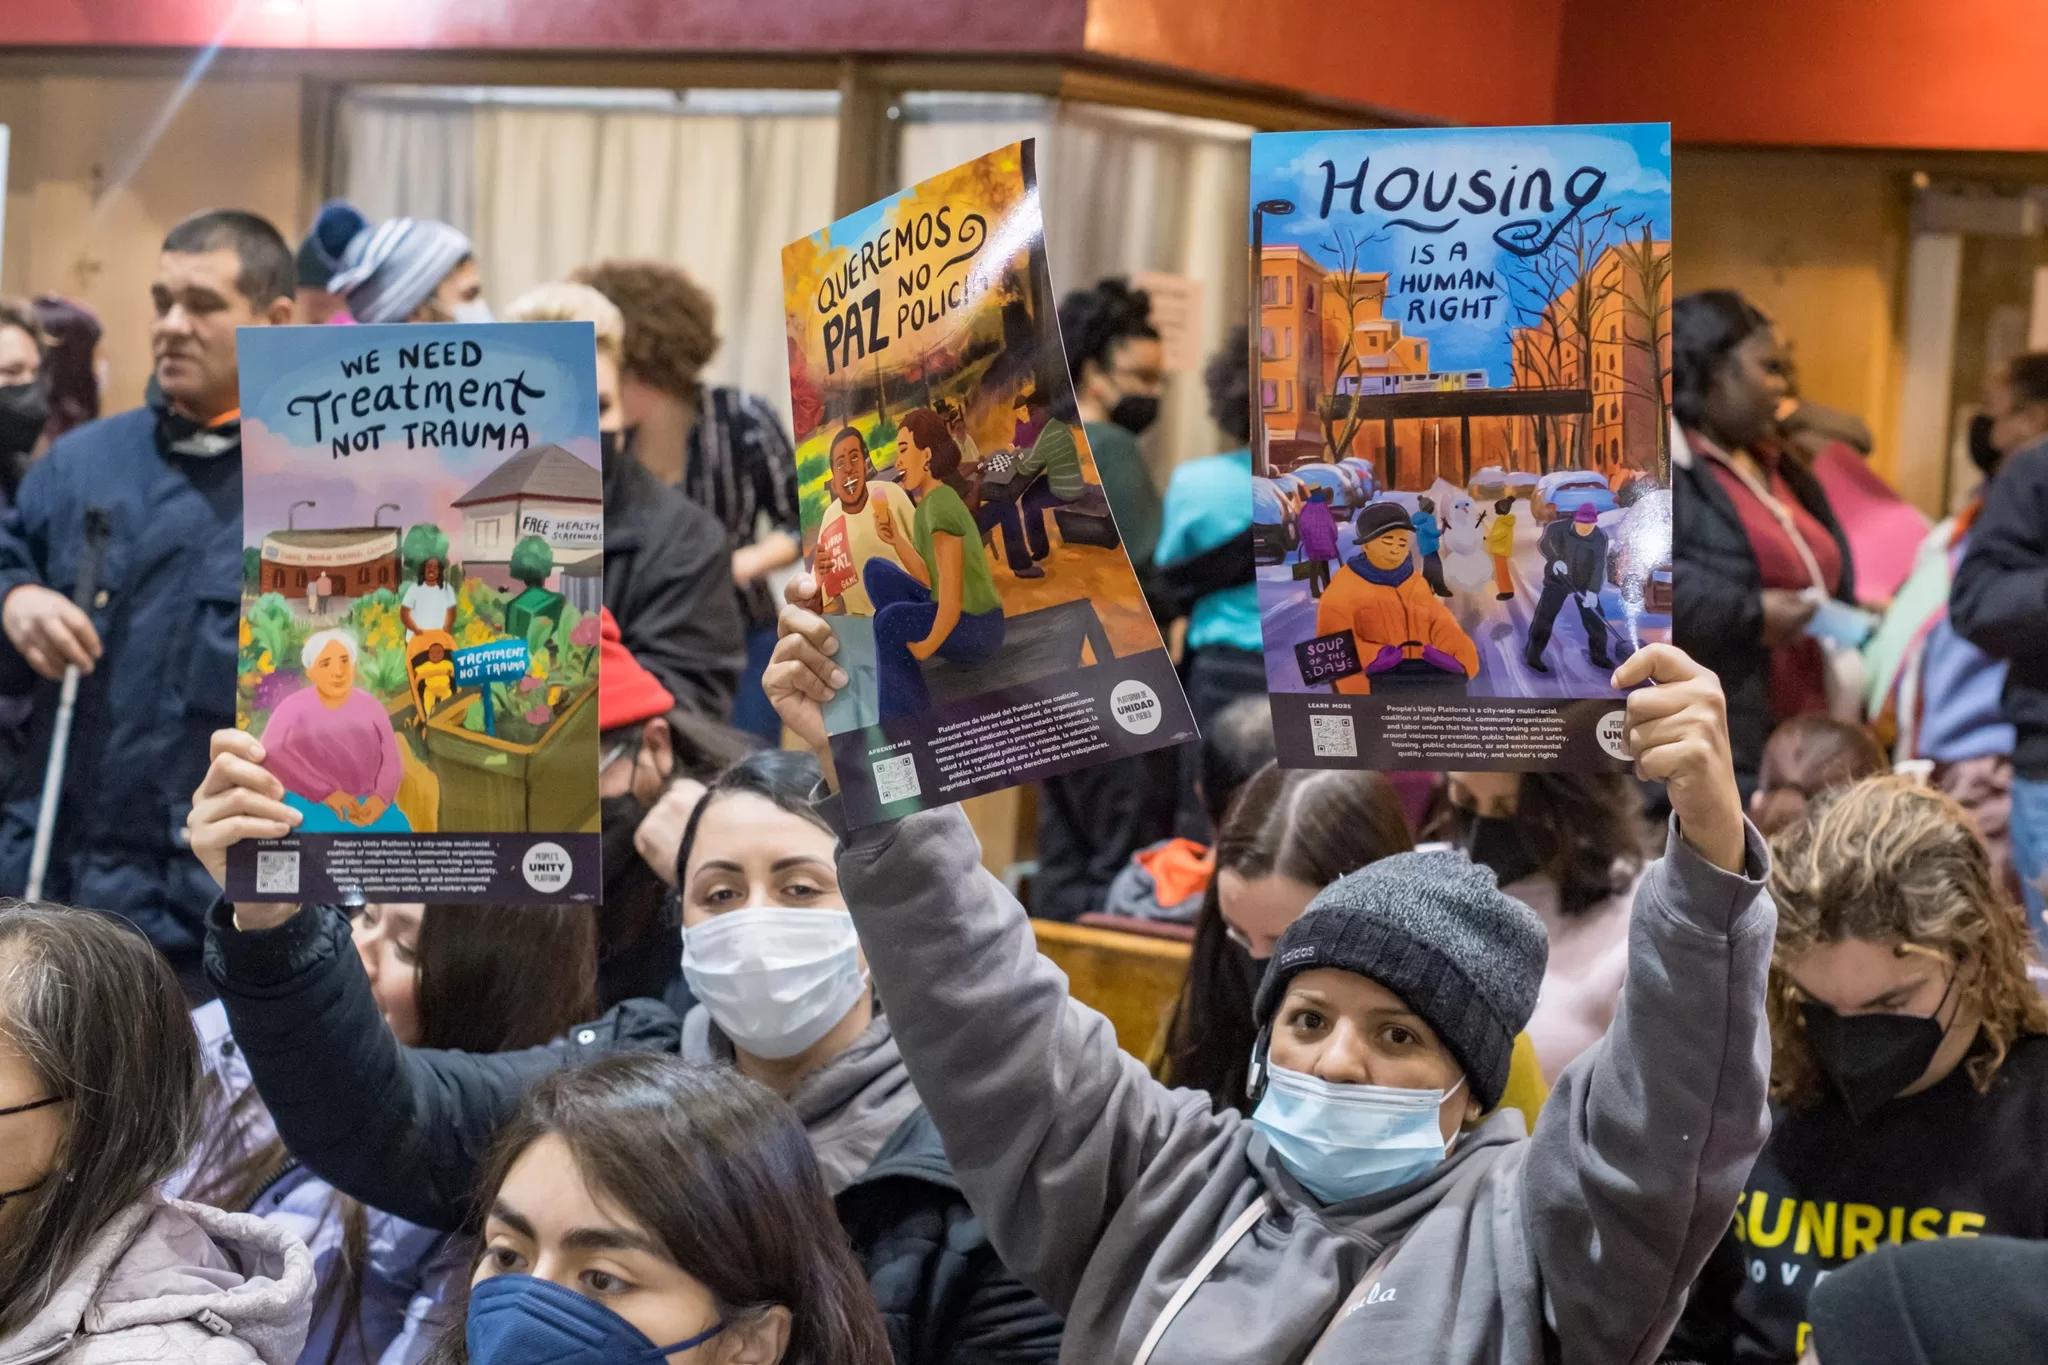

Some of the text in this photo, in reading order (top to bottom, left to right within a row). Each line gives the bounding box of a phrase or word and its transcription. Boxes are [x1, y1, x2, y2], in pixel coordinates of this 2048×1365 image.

[818, 205, 951, 314] QUEREMOS
[1410, 242, 1468, 265] IS A
[898, 264, 931, 298] NO
[1400, 268, 1495, 294] HUMAN
[1407, 295, 1498, 324] RIGHT
[823, 288, 890, 375] PAZ
[340, 340, 482, 378] WE NEED
[287, 370, 546, 443] Treatment
[332, 419, 529, 459] NOT TRAUMA
[523, 516, 599, 534] FREE HEALTH
[457, 647, 525, 666] TREATMENT
[1307, 638, 1344, 655] SOUP
[1310, 650, 1346, 665] OF THE
[460, 660, 525, 679] NOT TRAUMA
[1313, 660, 1346, 676] DAY
[938, 721, 970, 733] Plataforma
[980, 712, 1001, 722] Unidad
[1012, 704, 1033, 713] Pueblo
[1117, 700, 1154, 715] UNIDAD
[928, 732, 962, 746] multirracial
[963, 725, 990, 736] vecinales
[1052, 697, 1095, 712] organizaciones
[935, 740, 973, 754] comunitarias
[980, 730, 1009, 742] sindicatos
[1034, 718, 1053, 727] estado
[1054, 710, 1085, 721] trabajando
[868, 743, 896, 756] APRENDE
[936, 755, 955, 763] temas
[956, 744, 994, 758] relacionados
[940, 763, 957, 772] salud
[971, 751, 1001, 764] seguridad
[982, 760, 1005, 770] calidad
[1042, 745, 1060, 754] medio
[939, 778, 970, 792] seguridad
[972, 770, 1007, 783] comunitaria
[1024, 758, 1051, 768] derechos
[529, 863, 565, 872] UNITY
[1282, 946, 1315, 964] adidas
